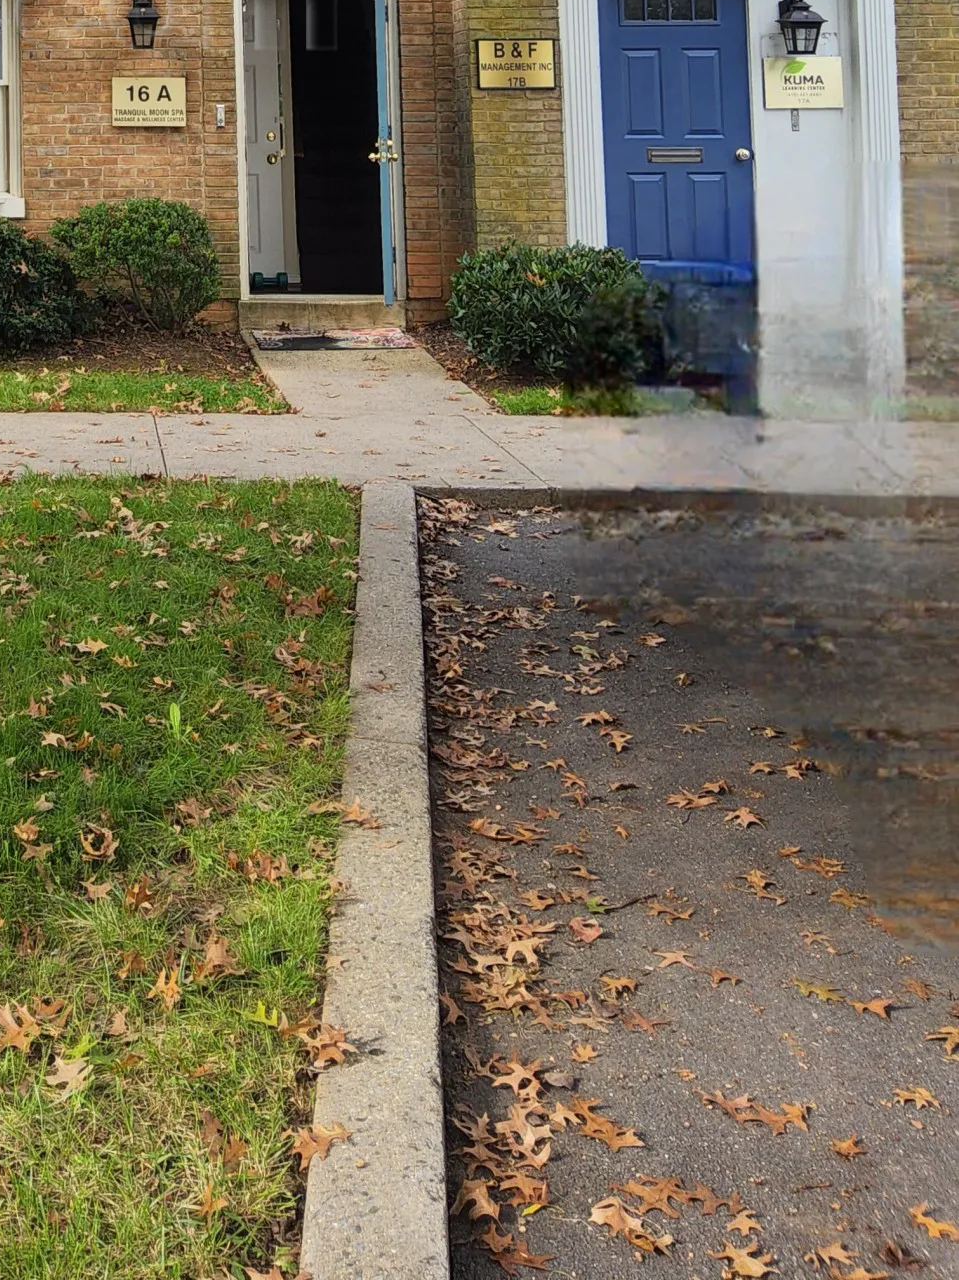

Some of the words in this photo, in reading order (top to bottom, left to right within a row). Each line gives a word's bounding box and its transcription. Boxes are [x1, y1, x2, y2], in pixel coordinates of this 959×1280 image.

[494, 42, 505, 58] B
[511, 42, 523, 58] &
[528, 42, 537, 58] F
[480, 63, 537, 71] MANAGEMENT
[538, 63, 552, 71] INC
[507, 77, 527, 87] 17B
[783, 75, 824, 85] KUMA
[126, 85, 150, 102] 16
[156, 84, 172, 102] A
